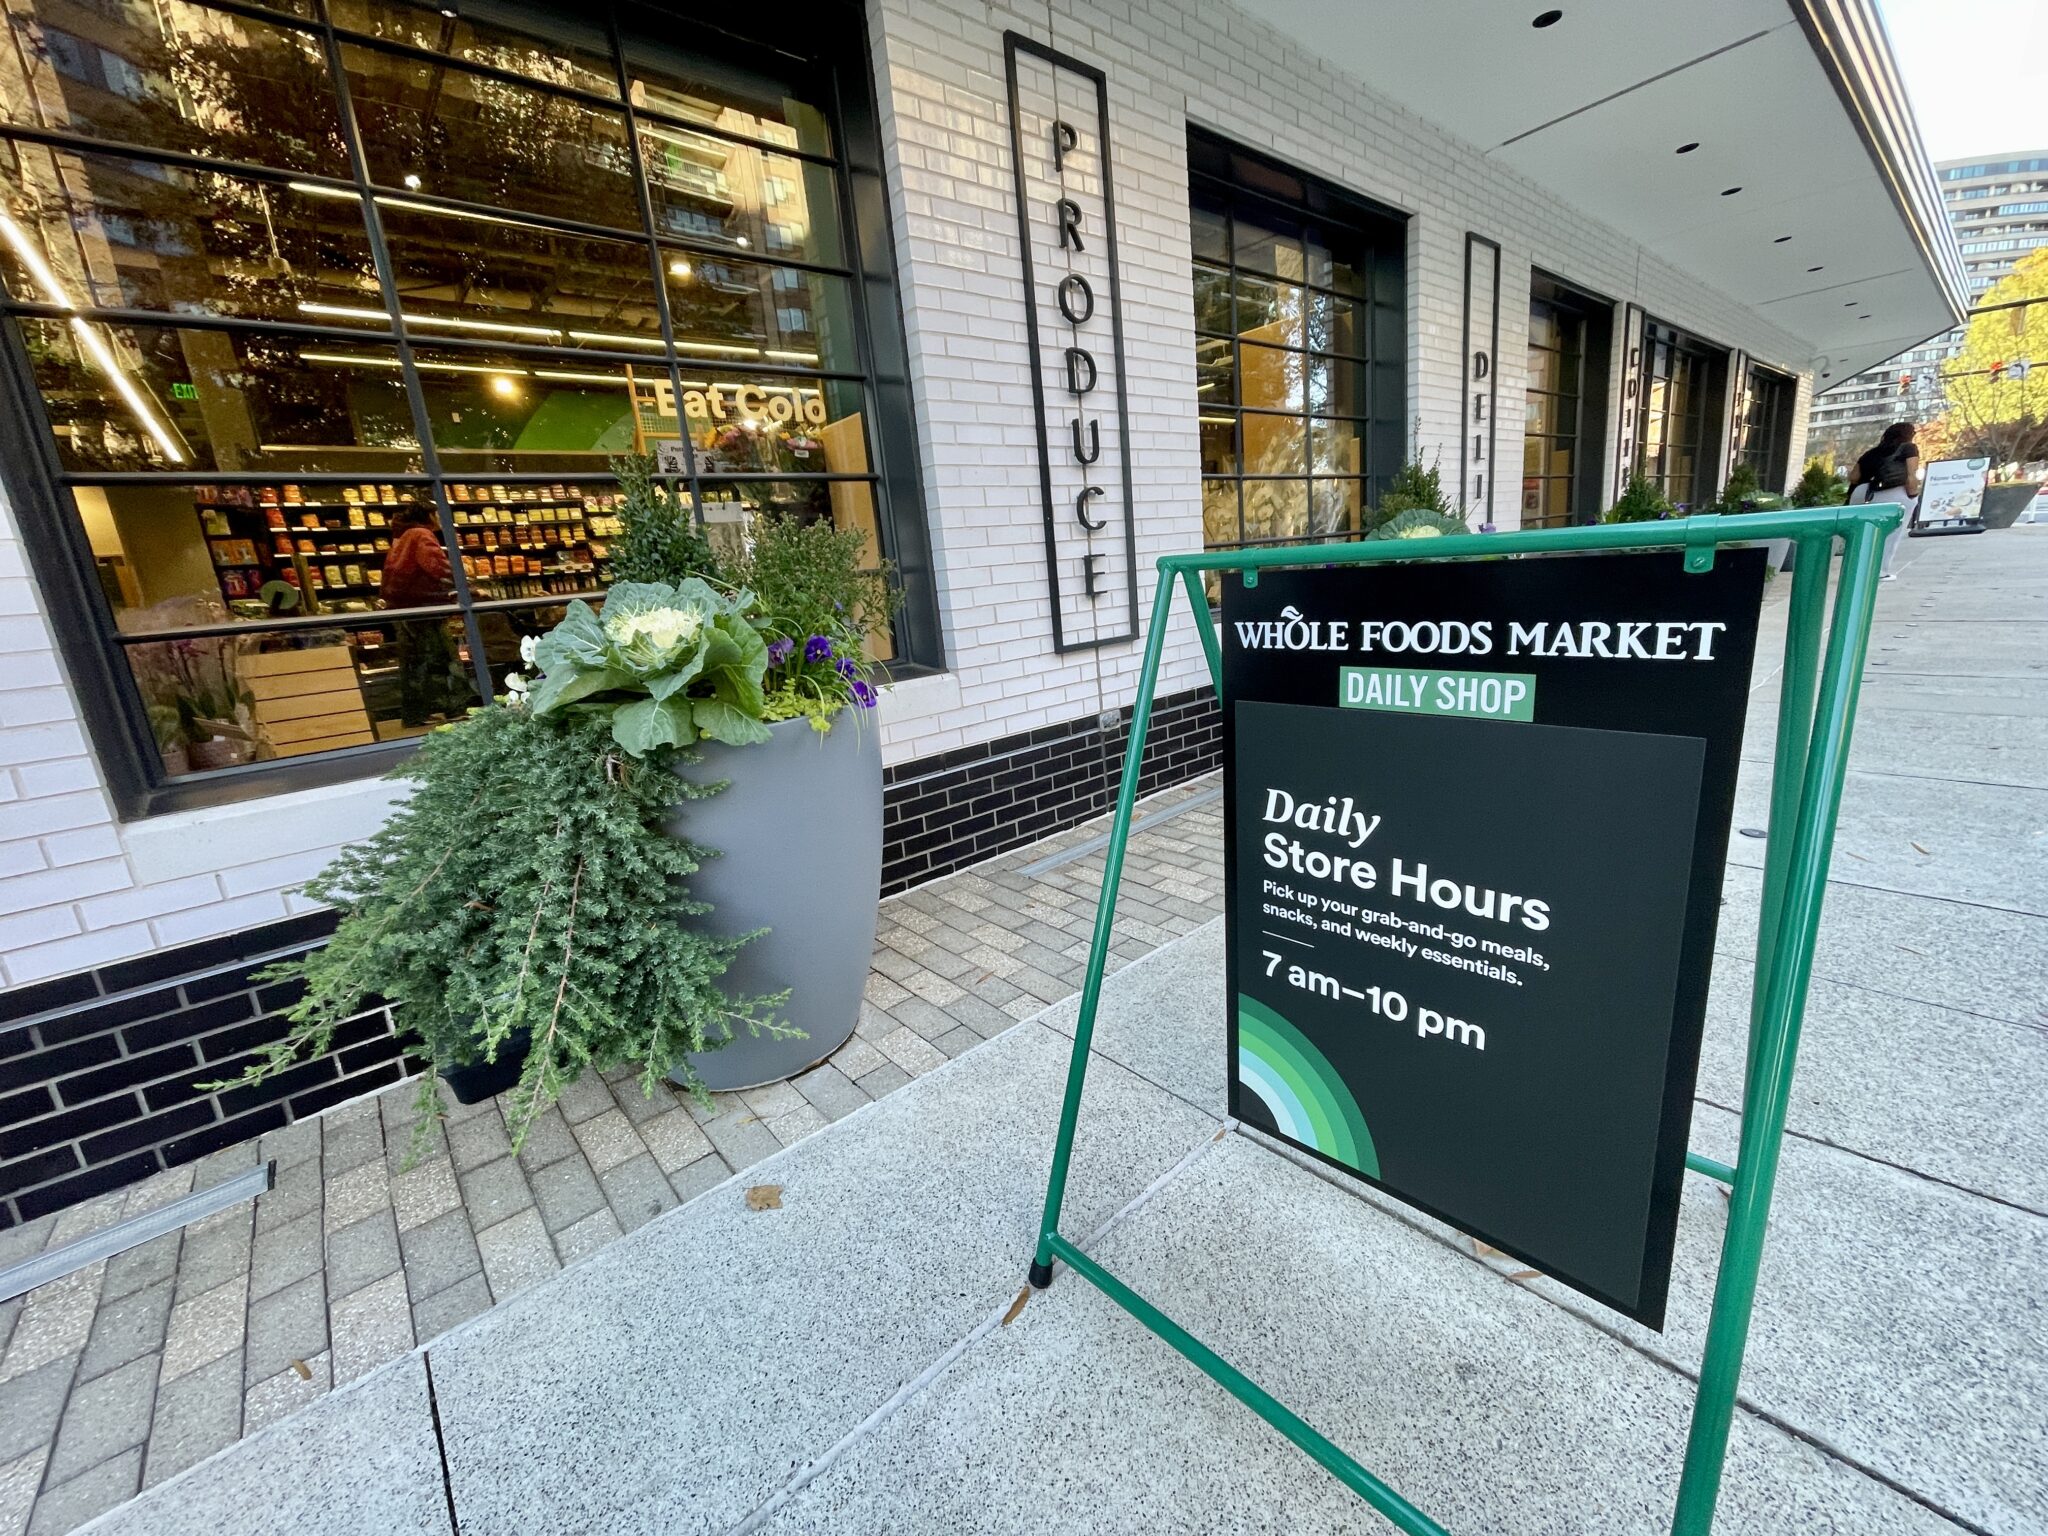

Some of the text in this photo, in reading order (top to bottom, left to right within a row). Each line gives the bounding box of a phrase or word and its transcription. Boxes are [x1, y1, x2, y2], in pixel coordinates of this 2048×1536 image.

[654, 379, 827, 424] Eat Cold
[1053, 119, 1109, 598] PRODUCE
[1474, 351, 1489, 499] DELI
[1235, 605, 1726, 661] WHOLE FOODS MARKET
[1347, 671, 1527, 714] DAILY SHOP
[1262, 788, 1381, 848] Daily
[1263, 832, 1551, 931] Store Hours
[1263, 879, 1551, 971] Pick up your grab-and-go meals,
[1263, 902, 1523, 986] snacks, and weekly essentials.
[1262, 949, 1282, 977] 7
[1418, 1007, 1485, 1050] pm
